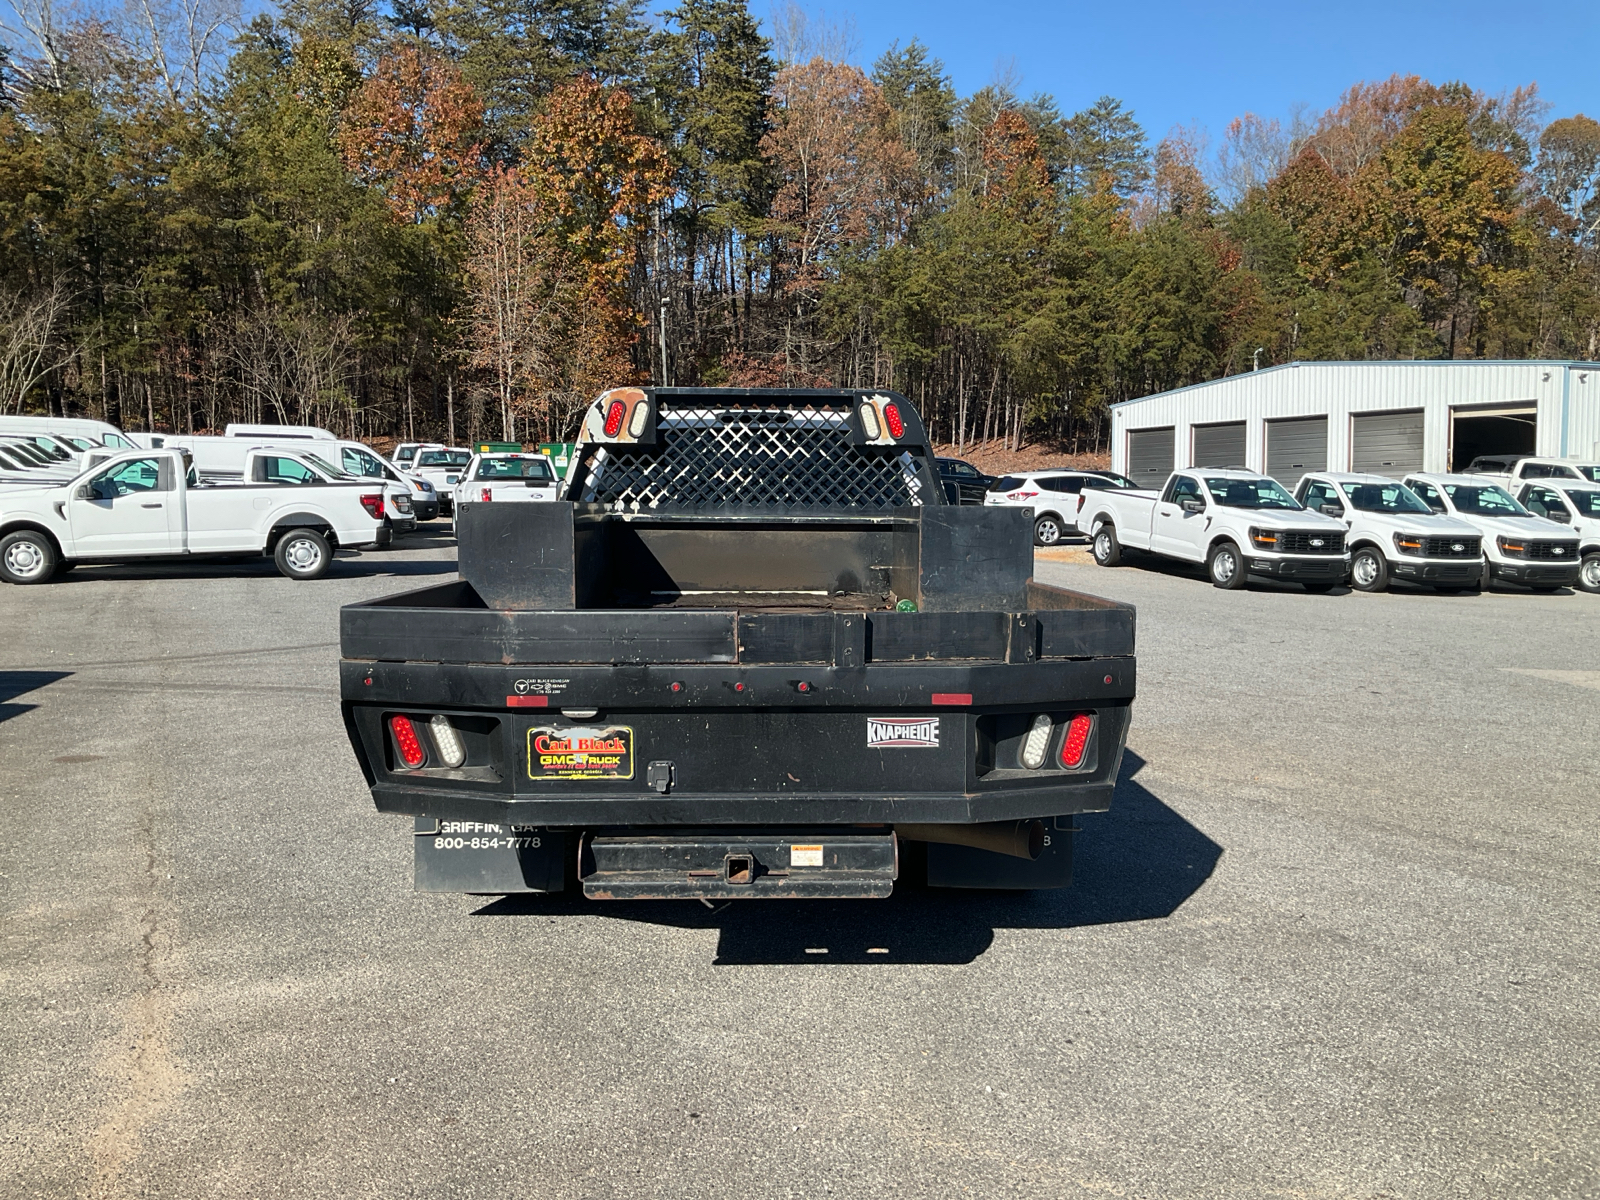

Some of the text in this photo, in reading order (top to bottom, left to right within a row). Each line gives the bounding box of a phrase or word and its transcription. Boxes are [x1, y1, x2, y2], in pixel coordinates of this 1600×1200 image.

[867, 722, 939, 743] KNAPHEIDE
[535, 735, 625, 752] Carl Black
[540, 755, 577, 764] GMC
[440, 821, 503, 834] GRIFFIN,
[434, 837, 542, 849] 800-854-7778
